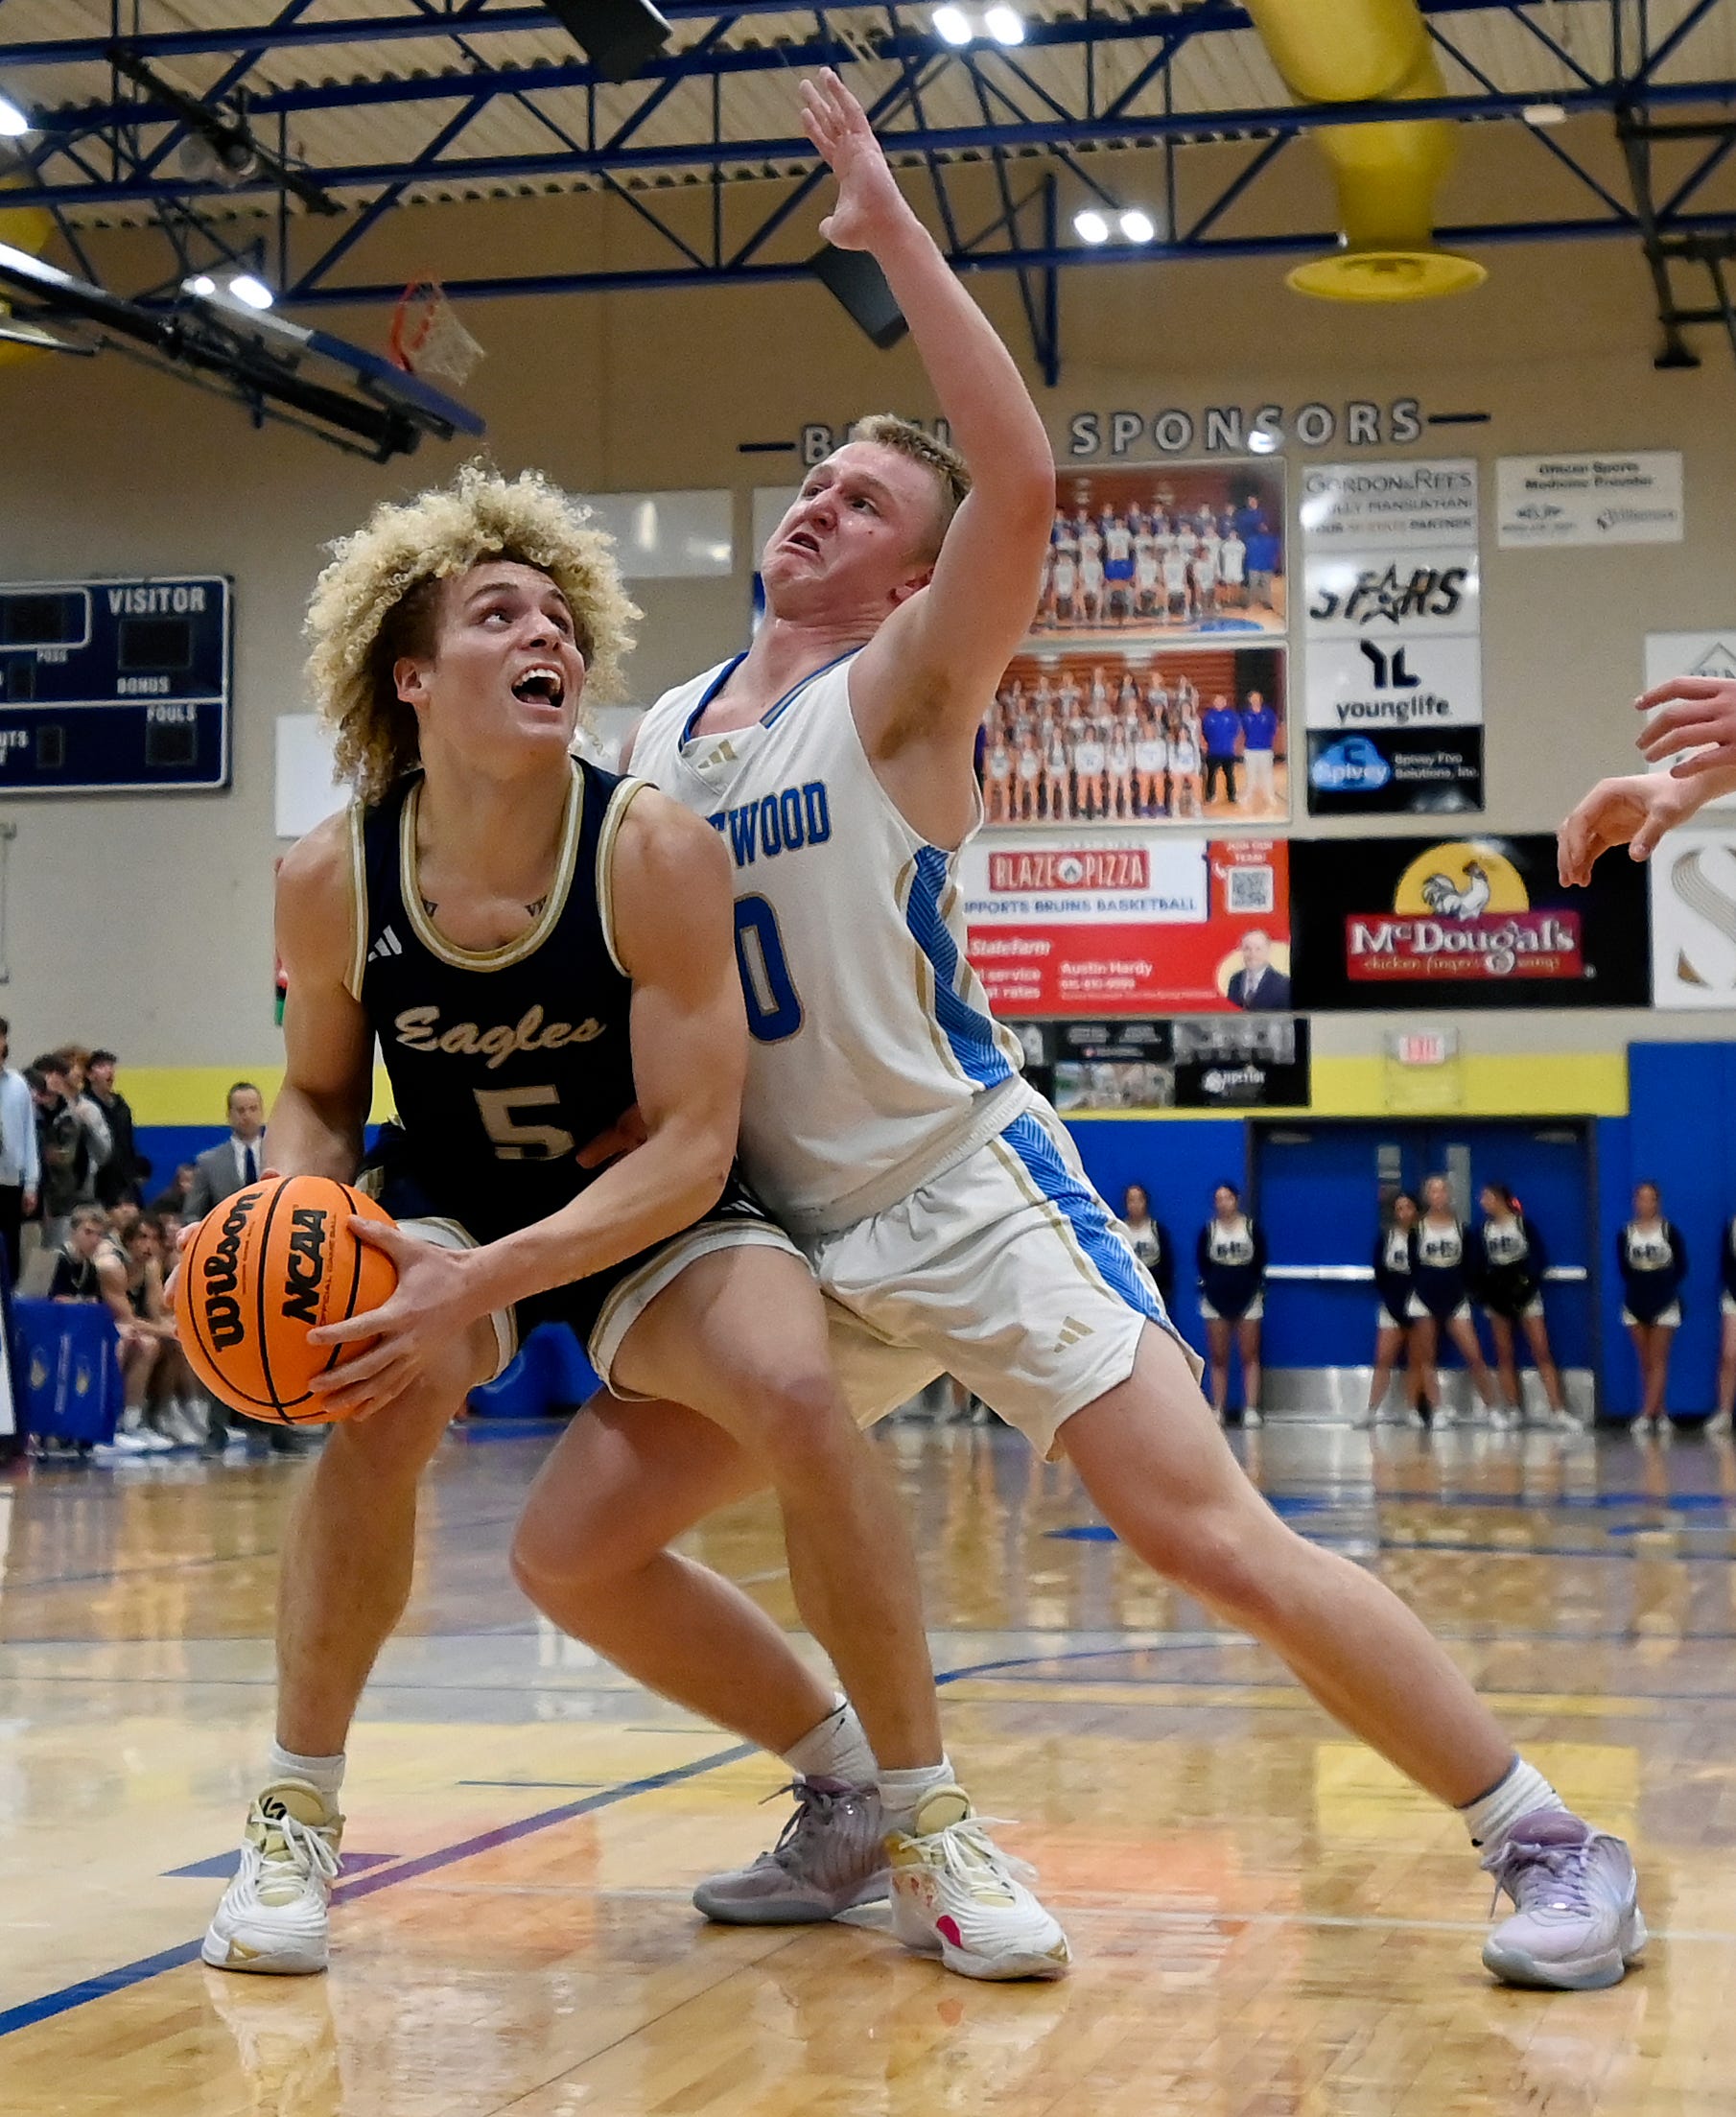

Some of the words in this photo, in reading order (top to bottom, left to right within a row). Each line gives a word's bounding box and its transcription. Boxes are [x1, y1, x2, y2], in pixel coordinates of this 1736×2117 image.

[1070, 398, 1420, 456] SPONSORS
[107, 586, 206, 616] VISITOR
[1360, 639, 1421, 689] YL
[116, 675, 170, 694] BONUS
[147, 704, 198, 722] FOULS
[1336, 693, 1451, 727] younglife
[0, 730, 29, 748] UTS
[995, 855, 1054, 888] BLAZE
[1085, 852, 1144, 887] PIZZA
[1035, 898, 1091, 913] BRUINS
[1096, 896, 1197, 912] BASKETBALL
[394, 1004, 607, 1070] Eagles
[473, 1084, 575, 1160] 5
[203, 1191, 264, 1353] Wilson
[282, 1209, 327, 1325] NCAA
